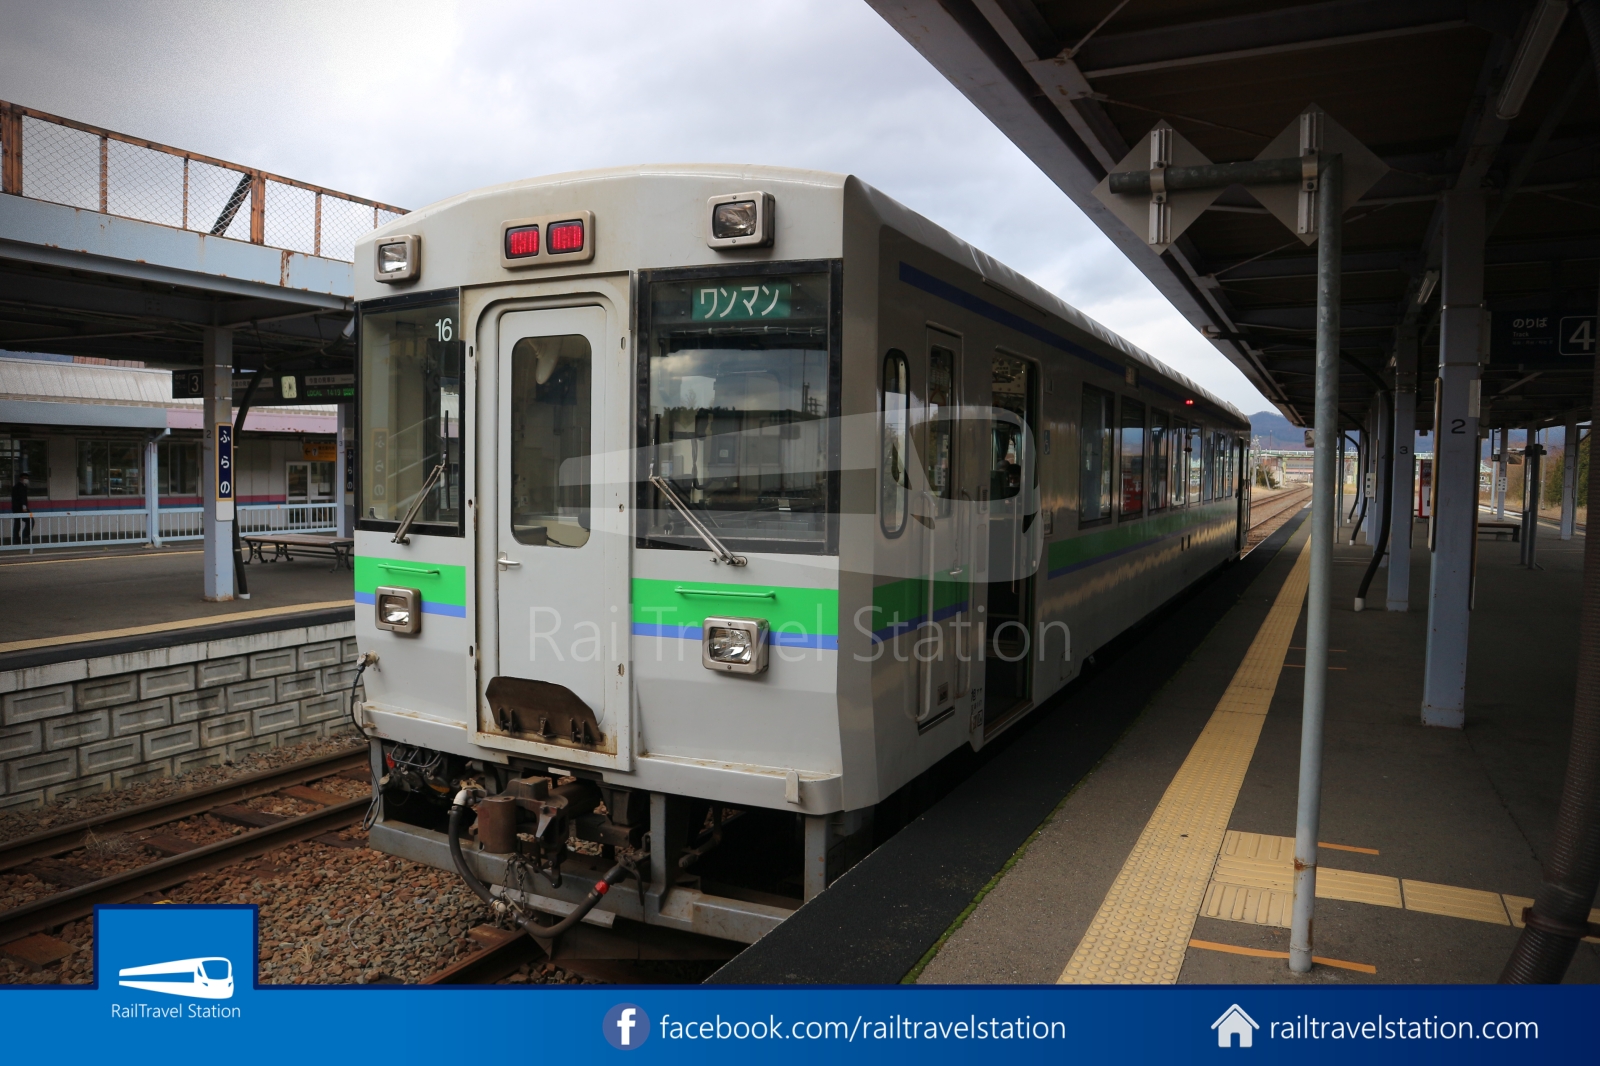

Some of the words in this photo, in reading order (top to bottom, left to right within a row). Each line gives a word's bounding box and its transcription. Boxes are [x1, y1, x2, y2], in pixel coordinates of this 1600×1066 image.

[700, 285, 779, 319] ワンマン
[435, 317, 453, 342] 16
[1513, 317, 1549, 329] のりば
[1568, 320, 1596, 351] 4
[191, 375, 199, 393] 3
[206, 430, 212, 439] 2
[1451, 419, 1466, 434] 2
[1399, 446, 1409, 455] 3
[219, 430, 231, 494] ふらの
